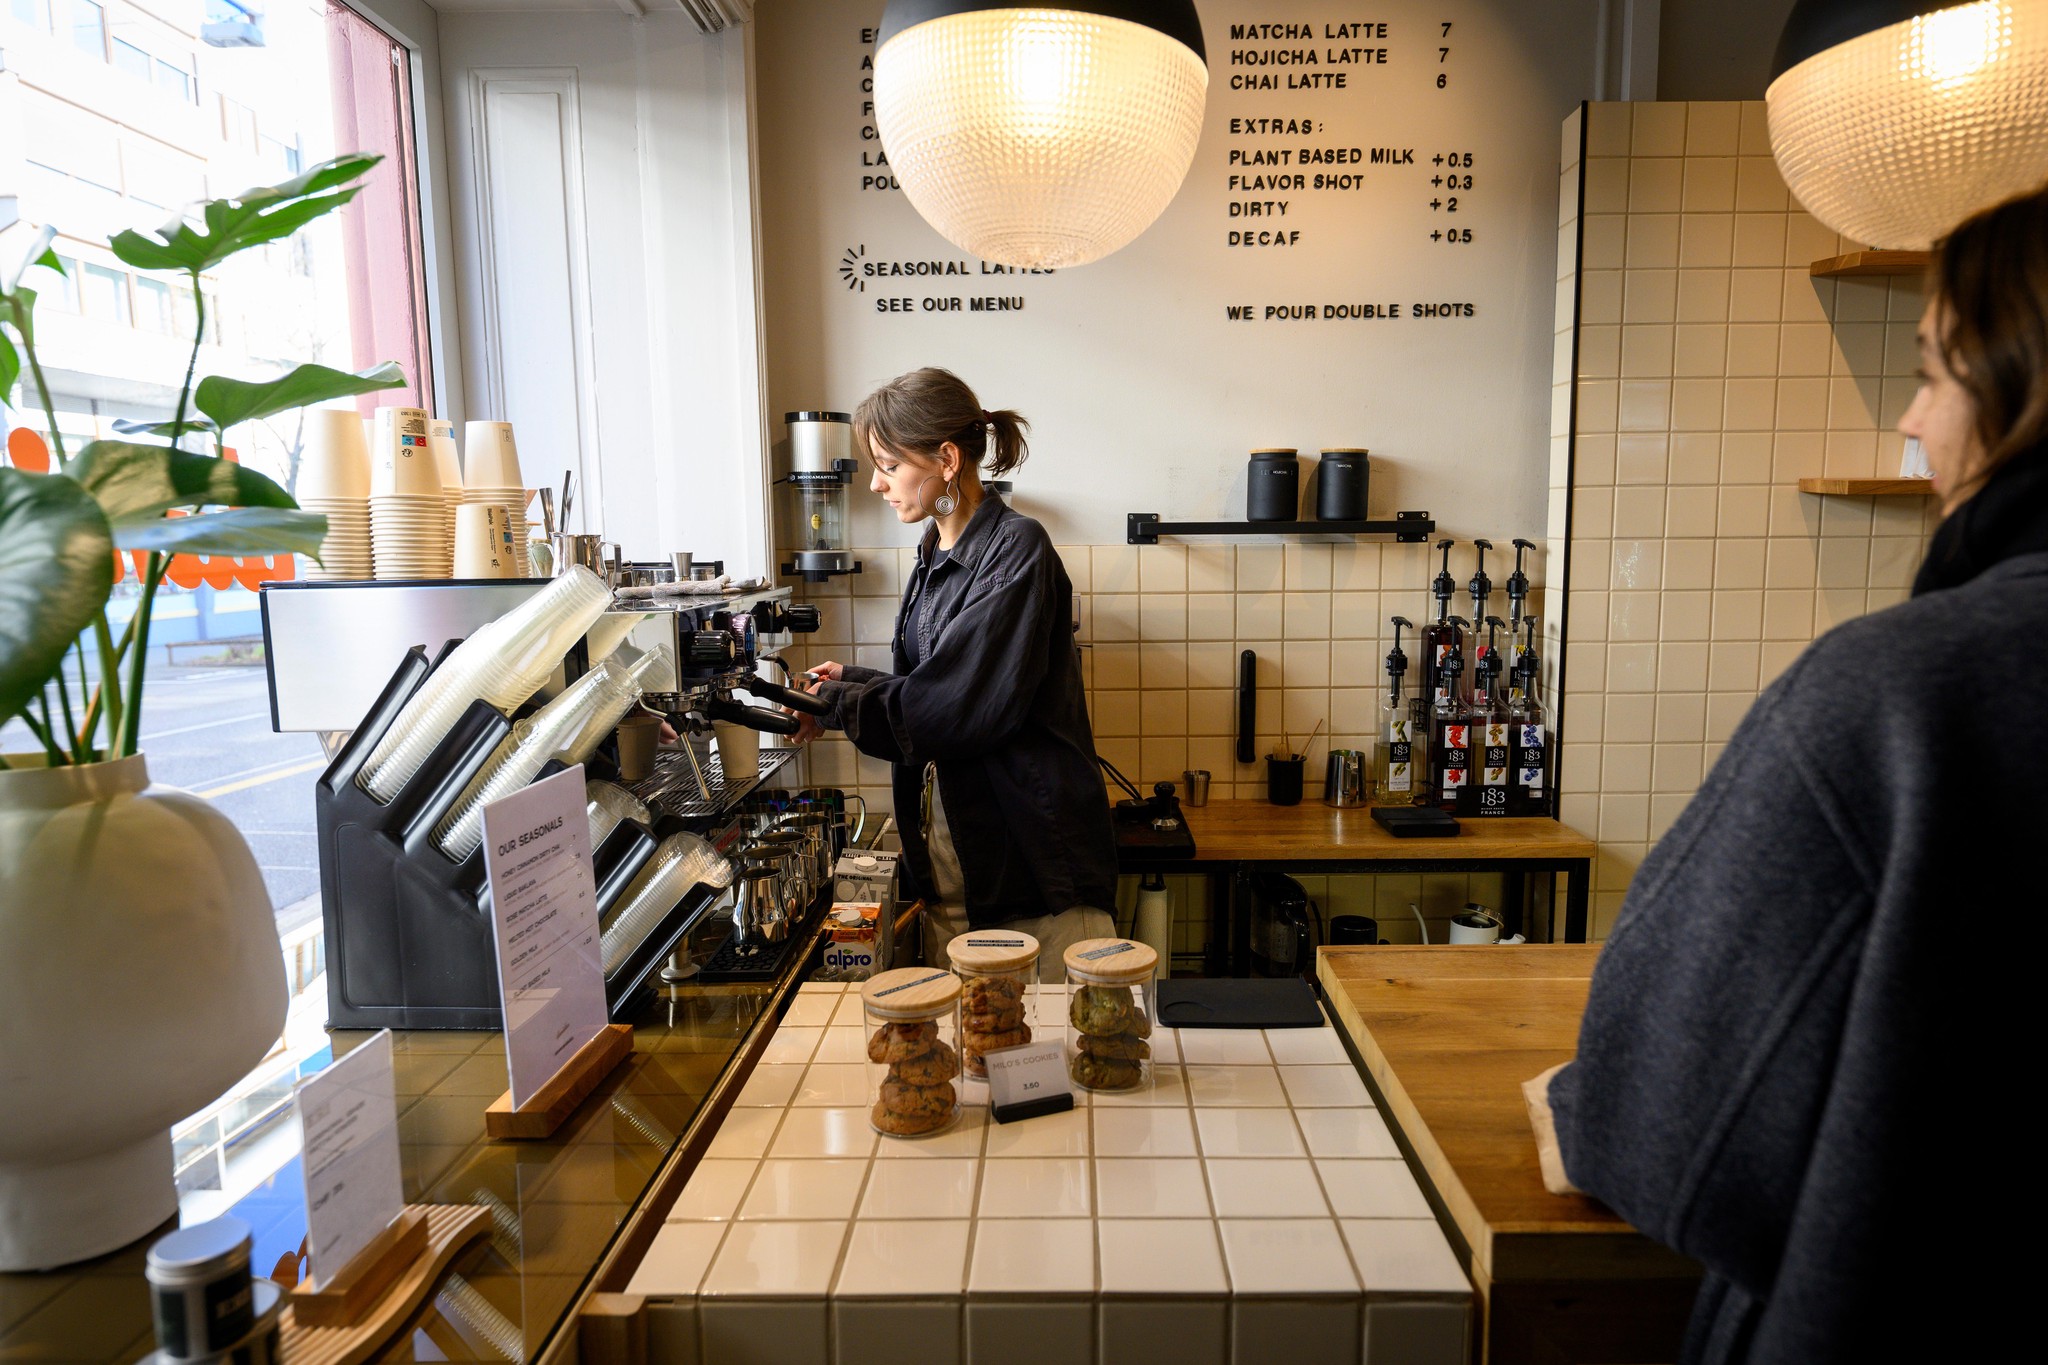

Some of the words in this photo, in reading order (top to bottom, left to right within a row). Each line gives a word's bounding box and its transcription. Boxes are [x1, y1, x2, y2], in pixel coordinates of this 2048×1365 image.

[1230, 24, 1312, 40] MATCHA
[1325, 23, 1387, 39] LATTE
[1441, 23, 1452, 37] 7
[1230, 50, 1318, 65] HOJICHA
[1327, 49, 1387, 64] LATTE
[1438, 48, 1449, 63] 7
[1230, 75, 1278, 90] CHAI
[1287, 74, 1346, 89] LATTE
[1436, 74, 1446, 88] 6
[1229, 150, 1292, 166] PLANT
[1299, 149, 1362, 164] BASED
[1370, 148, 1414, 164] MILK
[1228, 176, 1305, 191] FLAVOR
[1313, 175, 1364, 190] SHOT
[1229, 202, 1288, 217] DIRTY
[1228, 231, 1300, 246] DECAF
[864, 261, 970, 276] SEASONAL
[877, 299, 913, 312] SEE
[923, 298, 962, 311] OUR
[970, 296, 1023, 311] MENU
[1227, 306, 1254, 320] WE
[1265, 306, 1315, 320] POUR
[1323, 304, 1400, 319] DOUBLE
[1412, 303, 1474, 317] SHOTS
[498, 839, 516, 856] OUR
[518, 816, 563, 846] SEASONALS
[827, 950, 871, 970] alpro
[992, 1059, 1020, 1070] MILO'S
[1023, 1052, 1058, 1064] COOKIES
